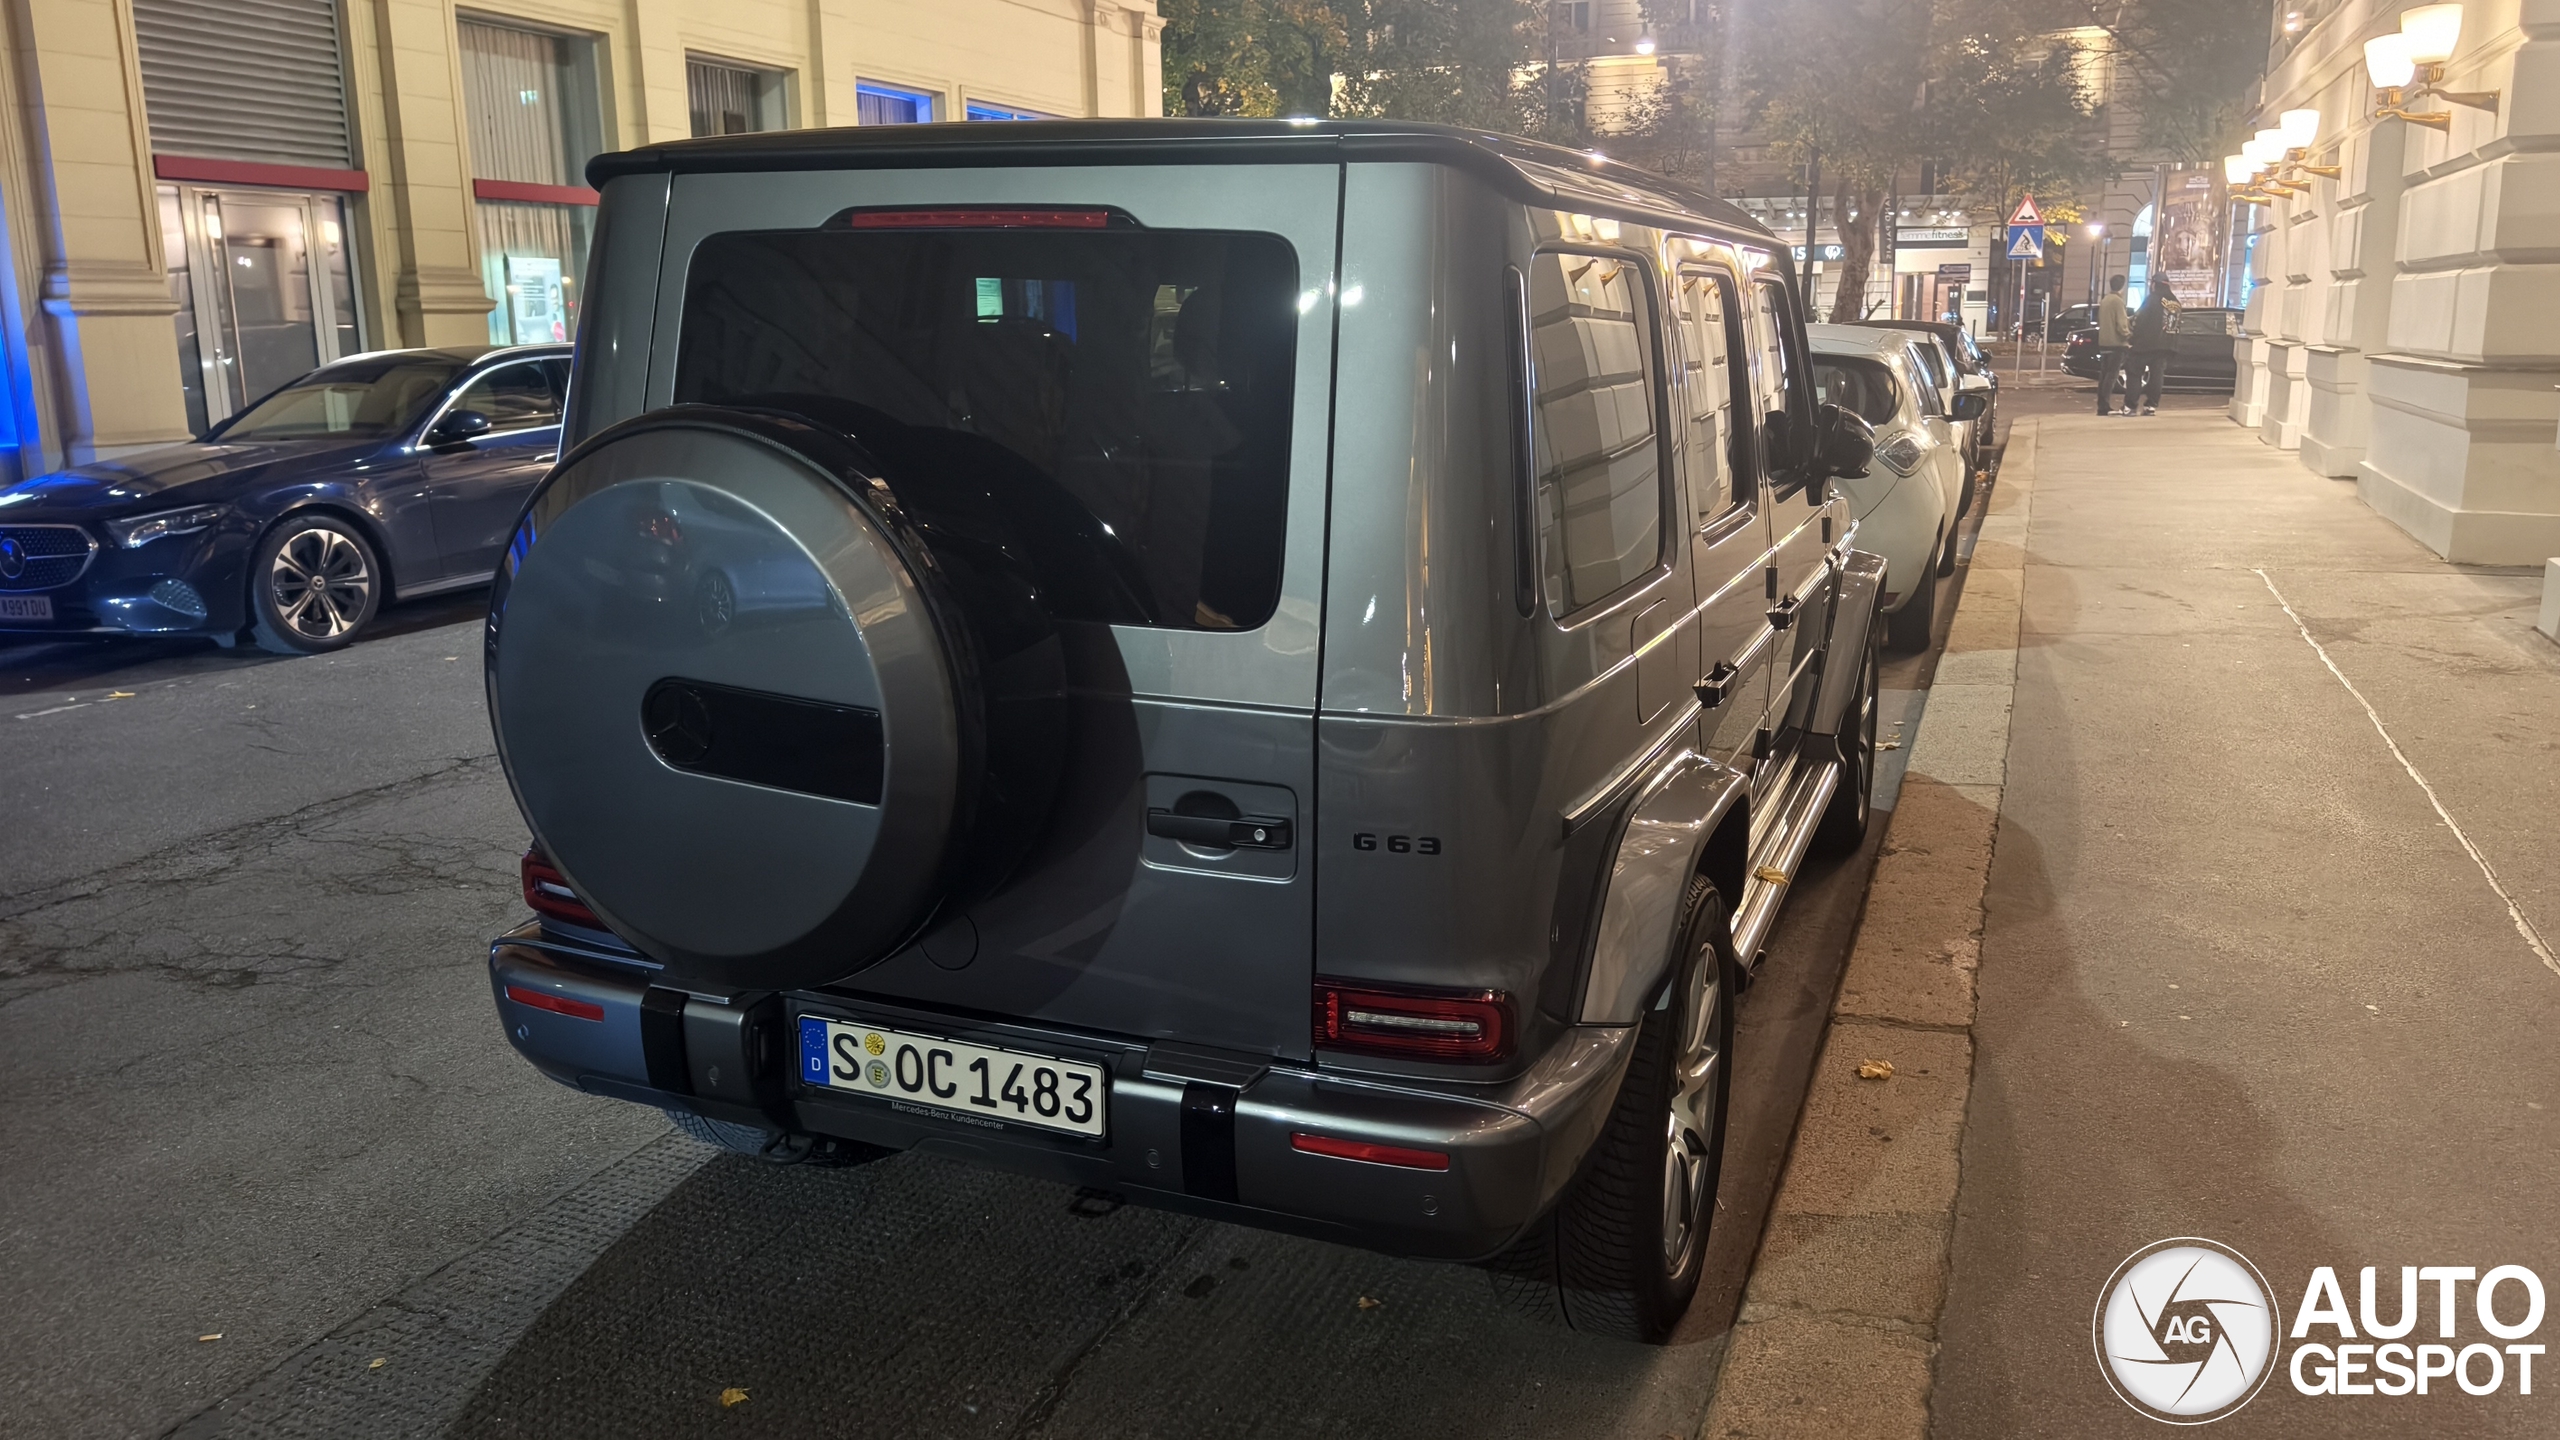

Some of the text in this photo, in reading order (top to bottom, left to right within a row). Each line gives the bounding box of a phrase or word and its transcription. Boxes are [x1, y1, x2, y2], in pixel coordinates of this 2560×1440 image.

[1353, 832, 1442, 856] G 63
[811, 1057, 821, 1071] D
[832, 1032, 1093, 1124] S OC 1483
[891, 1101, 1004, 1130] Mercedes-Benz Kundencenter
